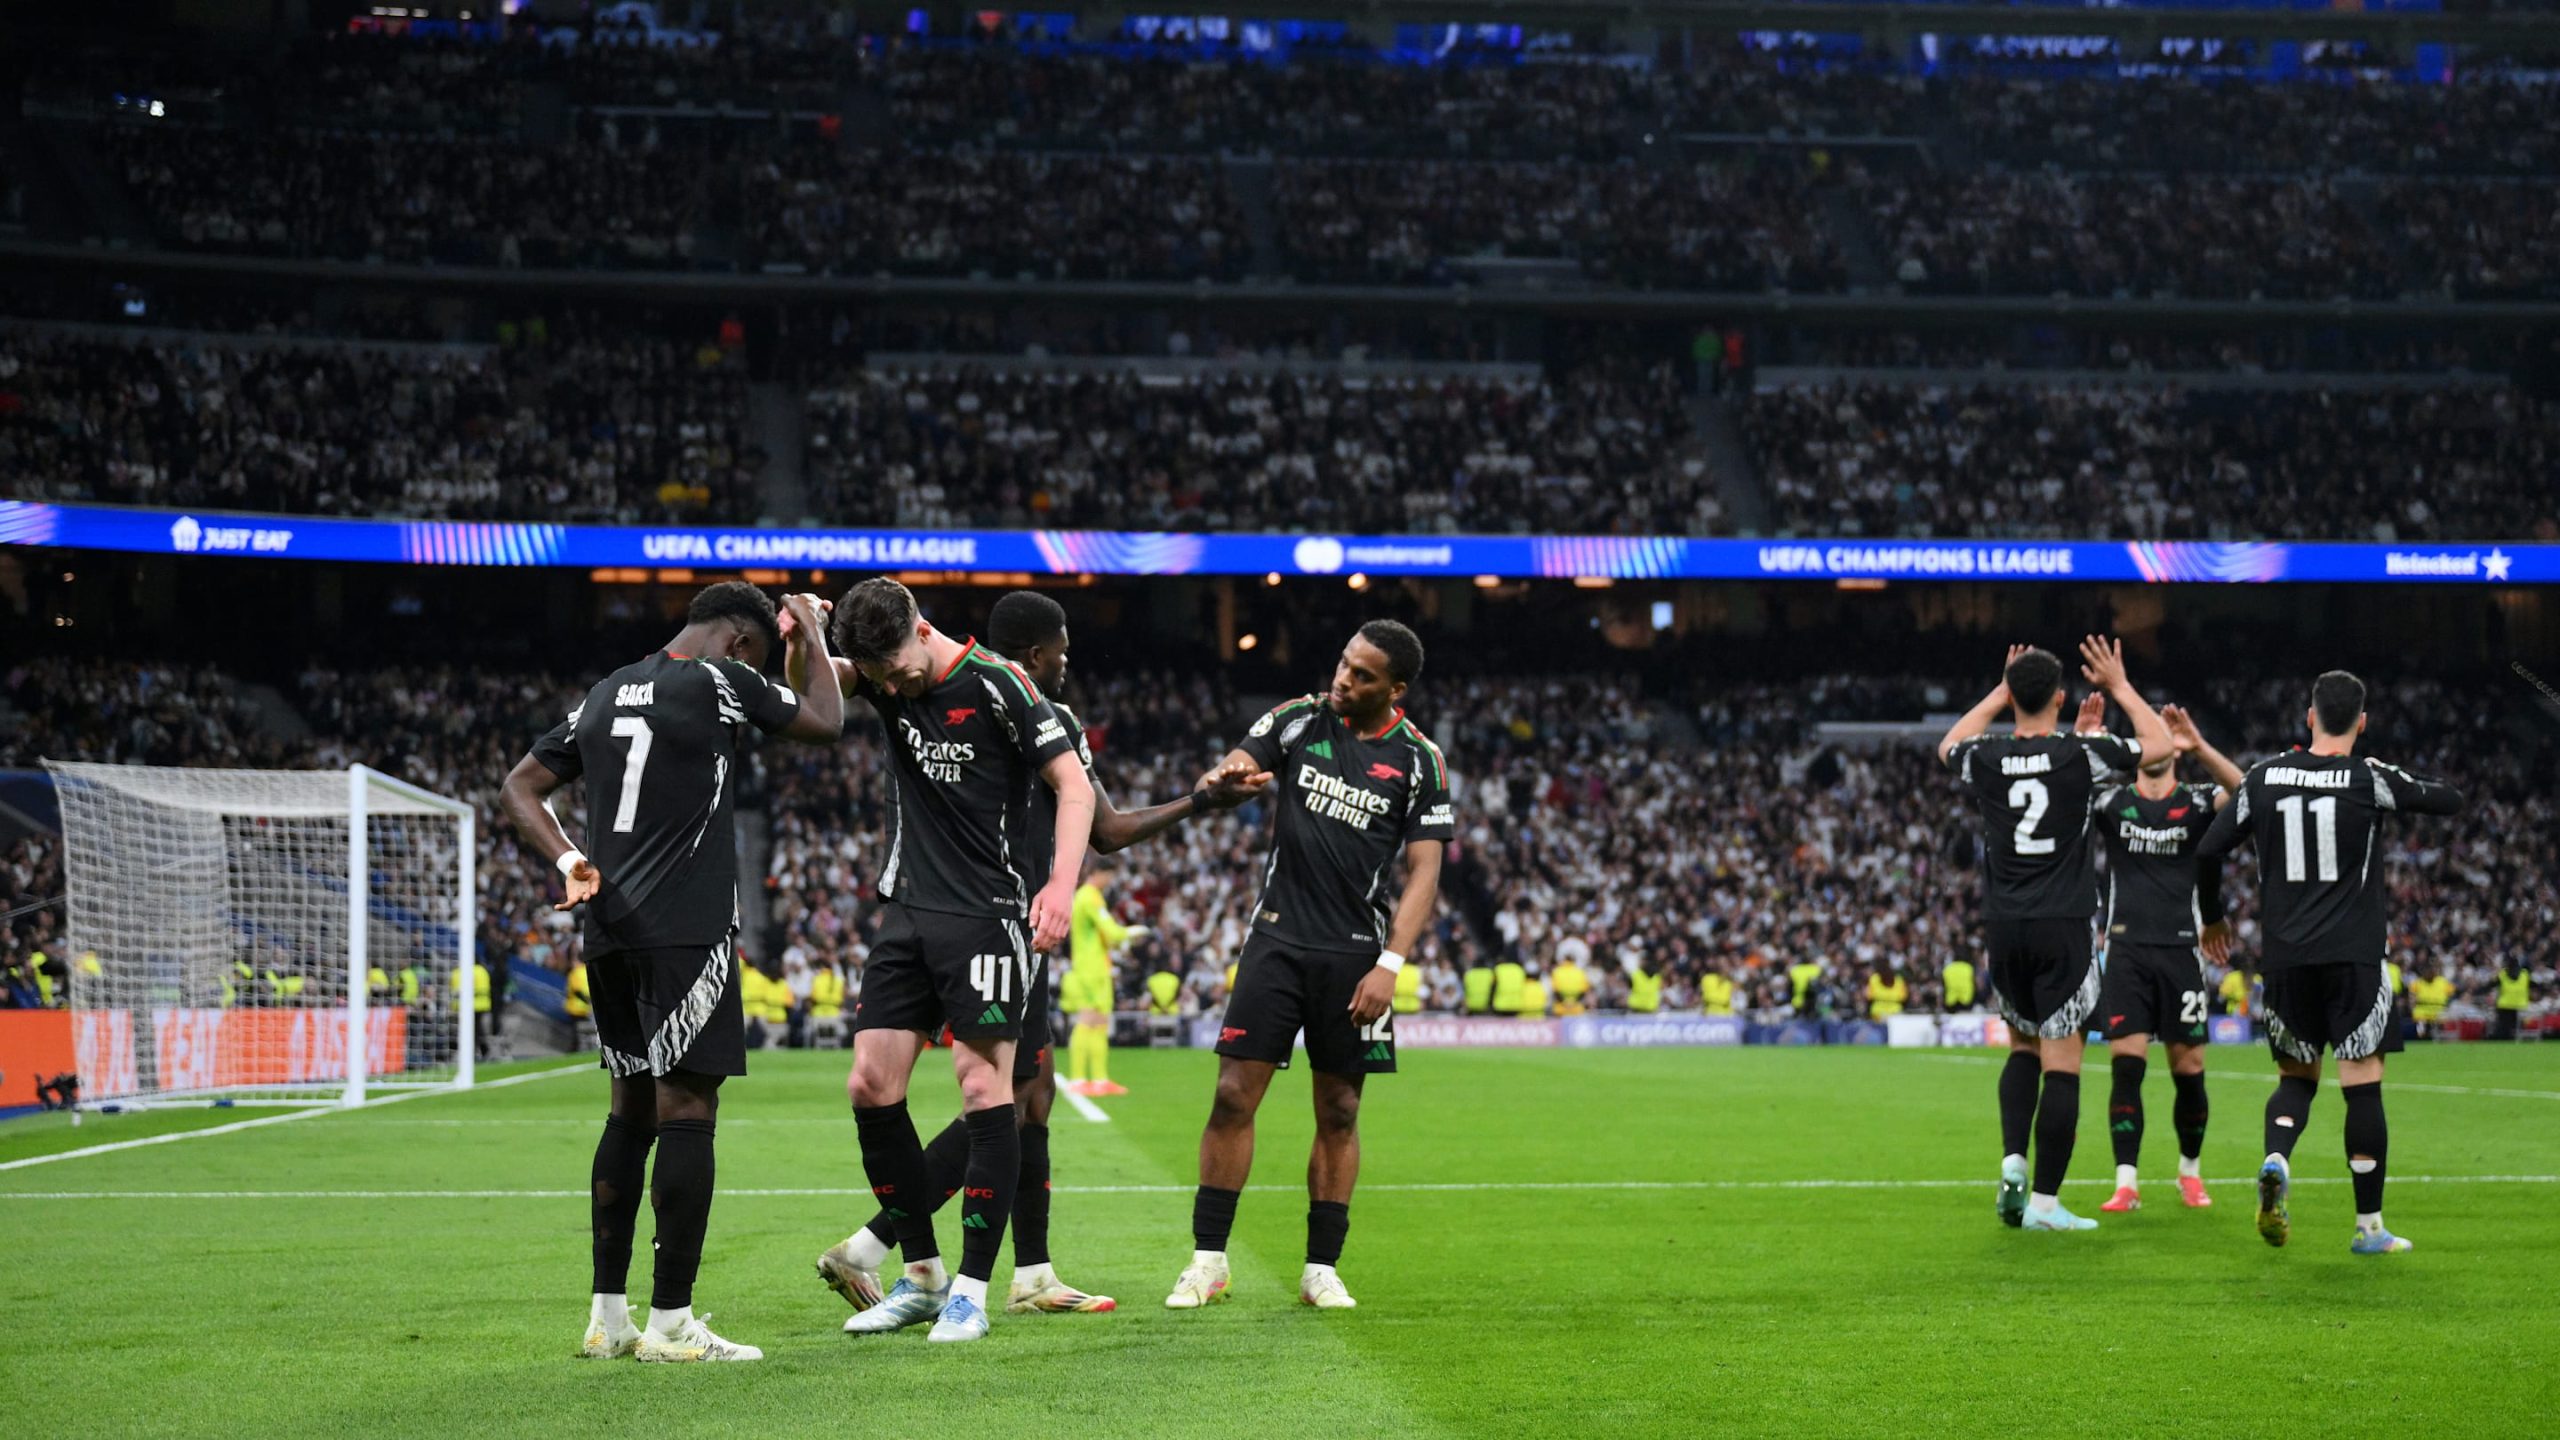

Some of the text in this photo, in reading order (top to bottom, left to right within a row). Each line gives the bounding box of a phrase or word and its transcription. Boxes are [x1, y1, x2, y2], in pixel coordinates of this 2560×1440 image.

[202, 527, 293, 552] JUST EAT
[643, 535, 977, 564] UEFA CHAMPIONS LEAGUE
[1347, 545, 1452, 566] mastercard
[1759, 547, 2072, 573] UEFA CHAMPIONS LEAGUE
[615, 681, 654, 707] SAKA
[610, 716, 654, 832] 7
[1297, 763, 1391, 815] Emirates
[2264, 767, 2350, 788] MARTINELLI
[1305, 791, 1371, 830] FLY BETTER
[2008, 778, 2055, 855] 2
[2276, 795, 2339, 882] 11
[969, 954, 1012, 1003] 41
[2179, 990, 2208, 1024] 23
[1602, 1020, 1736, 1047] crypto.com
